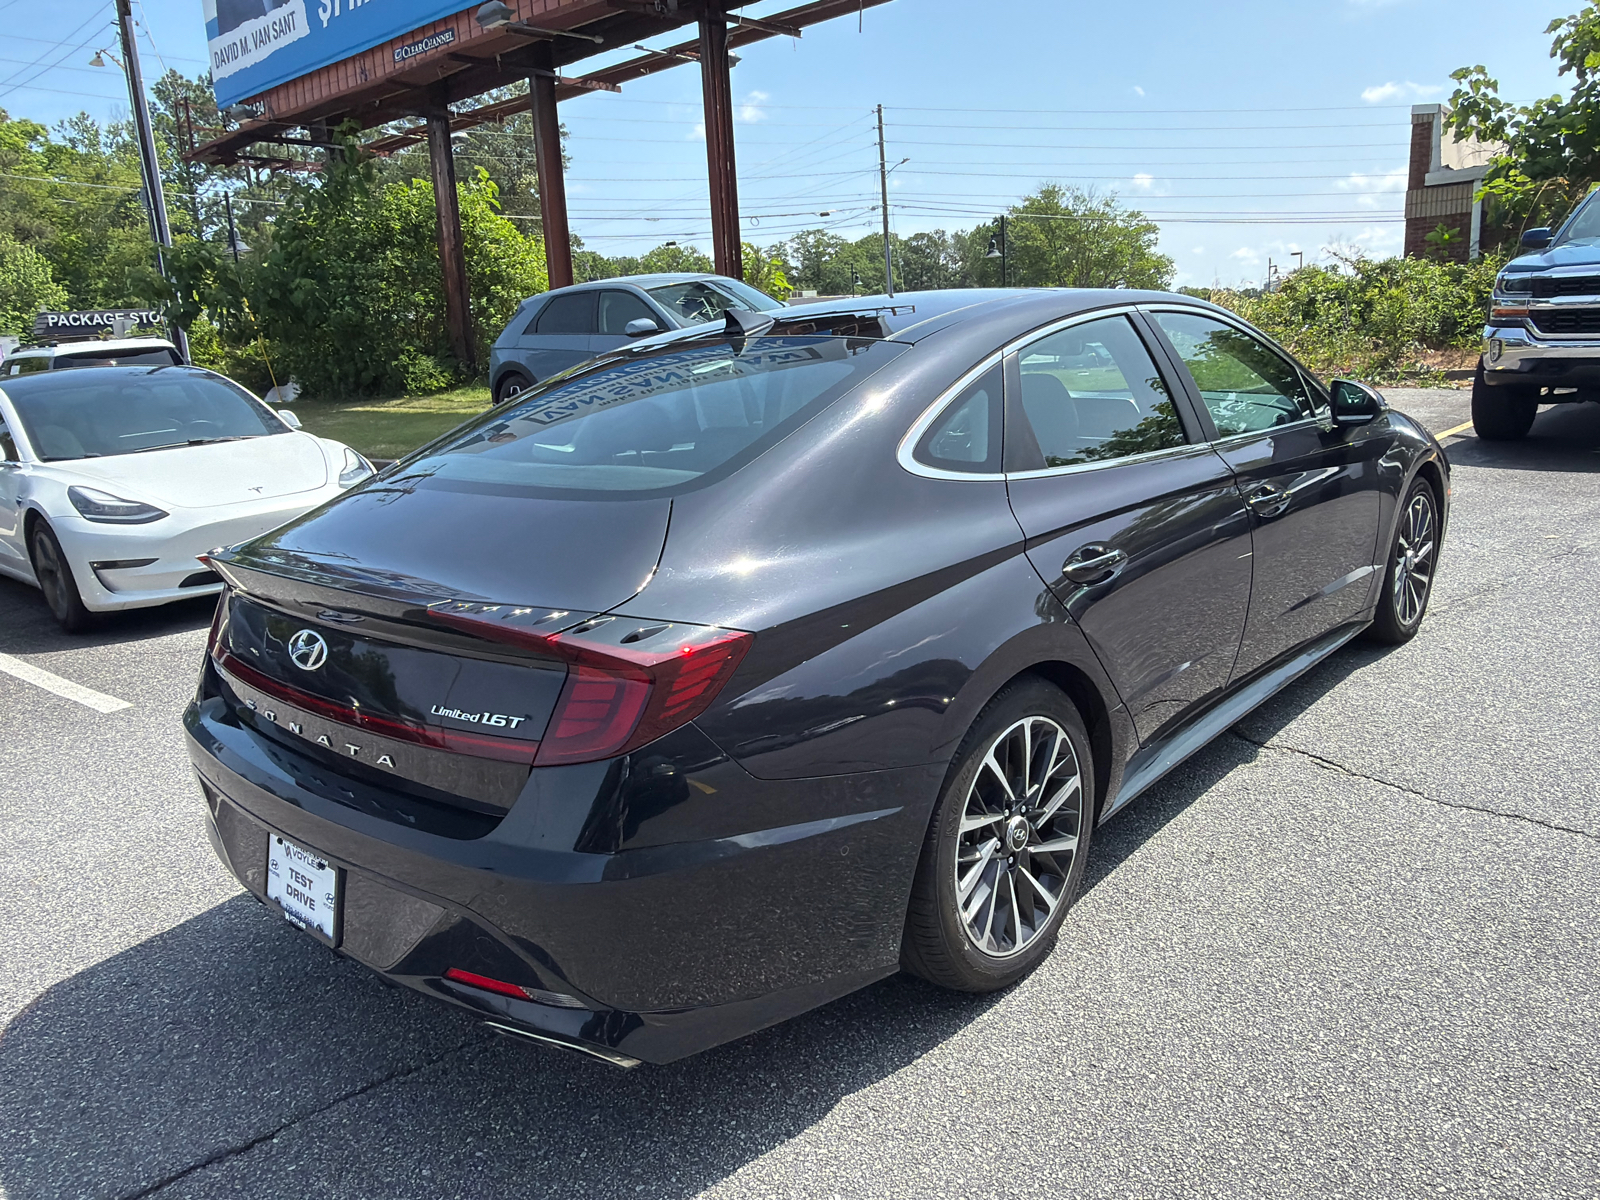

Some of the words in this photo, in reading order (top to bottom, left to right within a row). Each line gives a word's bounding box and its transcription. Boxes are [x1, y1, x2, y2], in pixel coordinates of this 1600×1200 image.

[214, 41, 239, 69] DAVID
[239, 36, 252, 57] M.
[251, 24, 271, 51] VAN
[271, 10, 296, 40] SANT
[430, 704, 480, 722] Limited
[246, 699, 396, 768] SONATA
[288, 866, 313, 891] TEST
[286, 883, 316, 911] DRIVE
